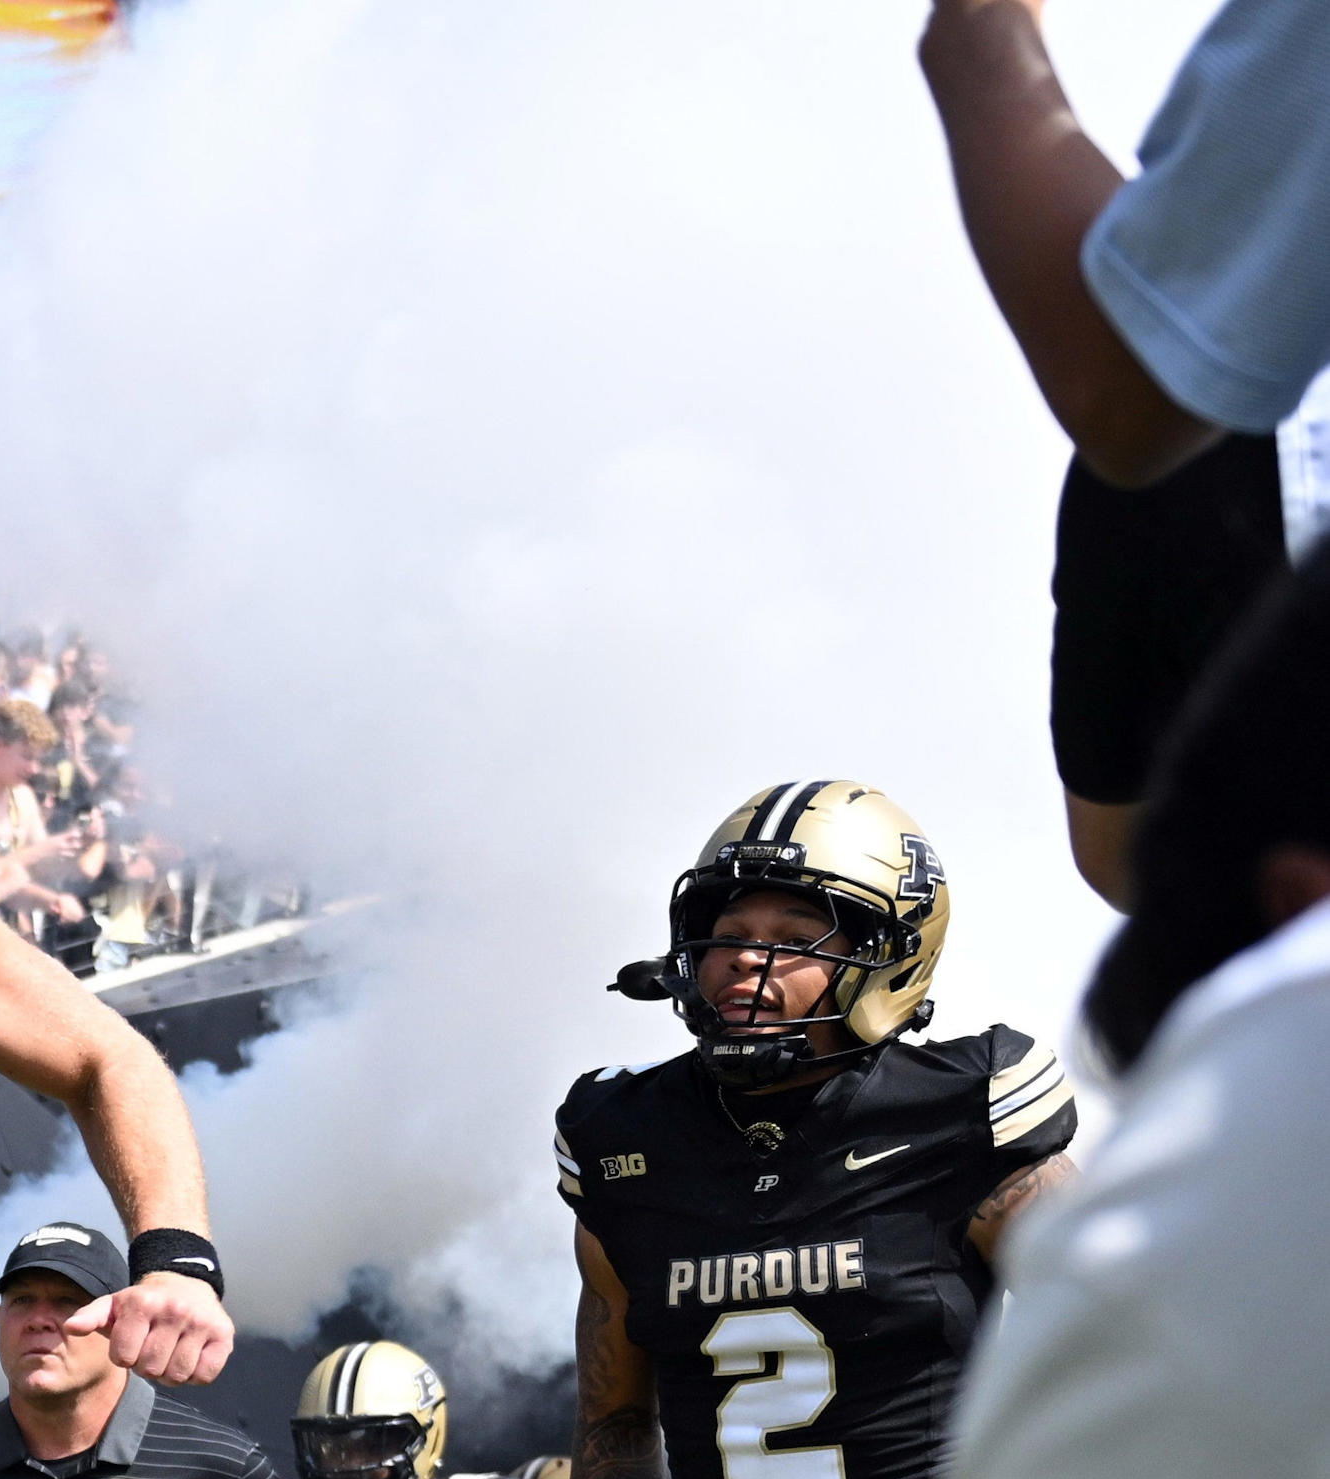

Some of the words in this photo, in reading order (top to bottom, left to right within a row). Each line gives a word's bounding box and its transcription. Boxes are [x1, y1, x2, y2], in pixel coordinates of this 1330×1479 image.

[712, 1045, 740, 1057] BOILER
[742, 1044, 756, 1057] UP
[753, 1174, 780, 1193] P
[667, 1237, 867, 1309] PURDUE
